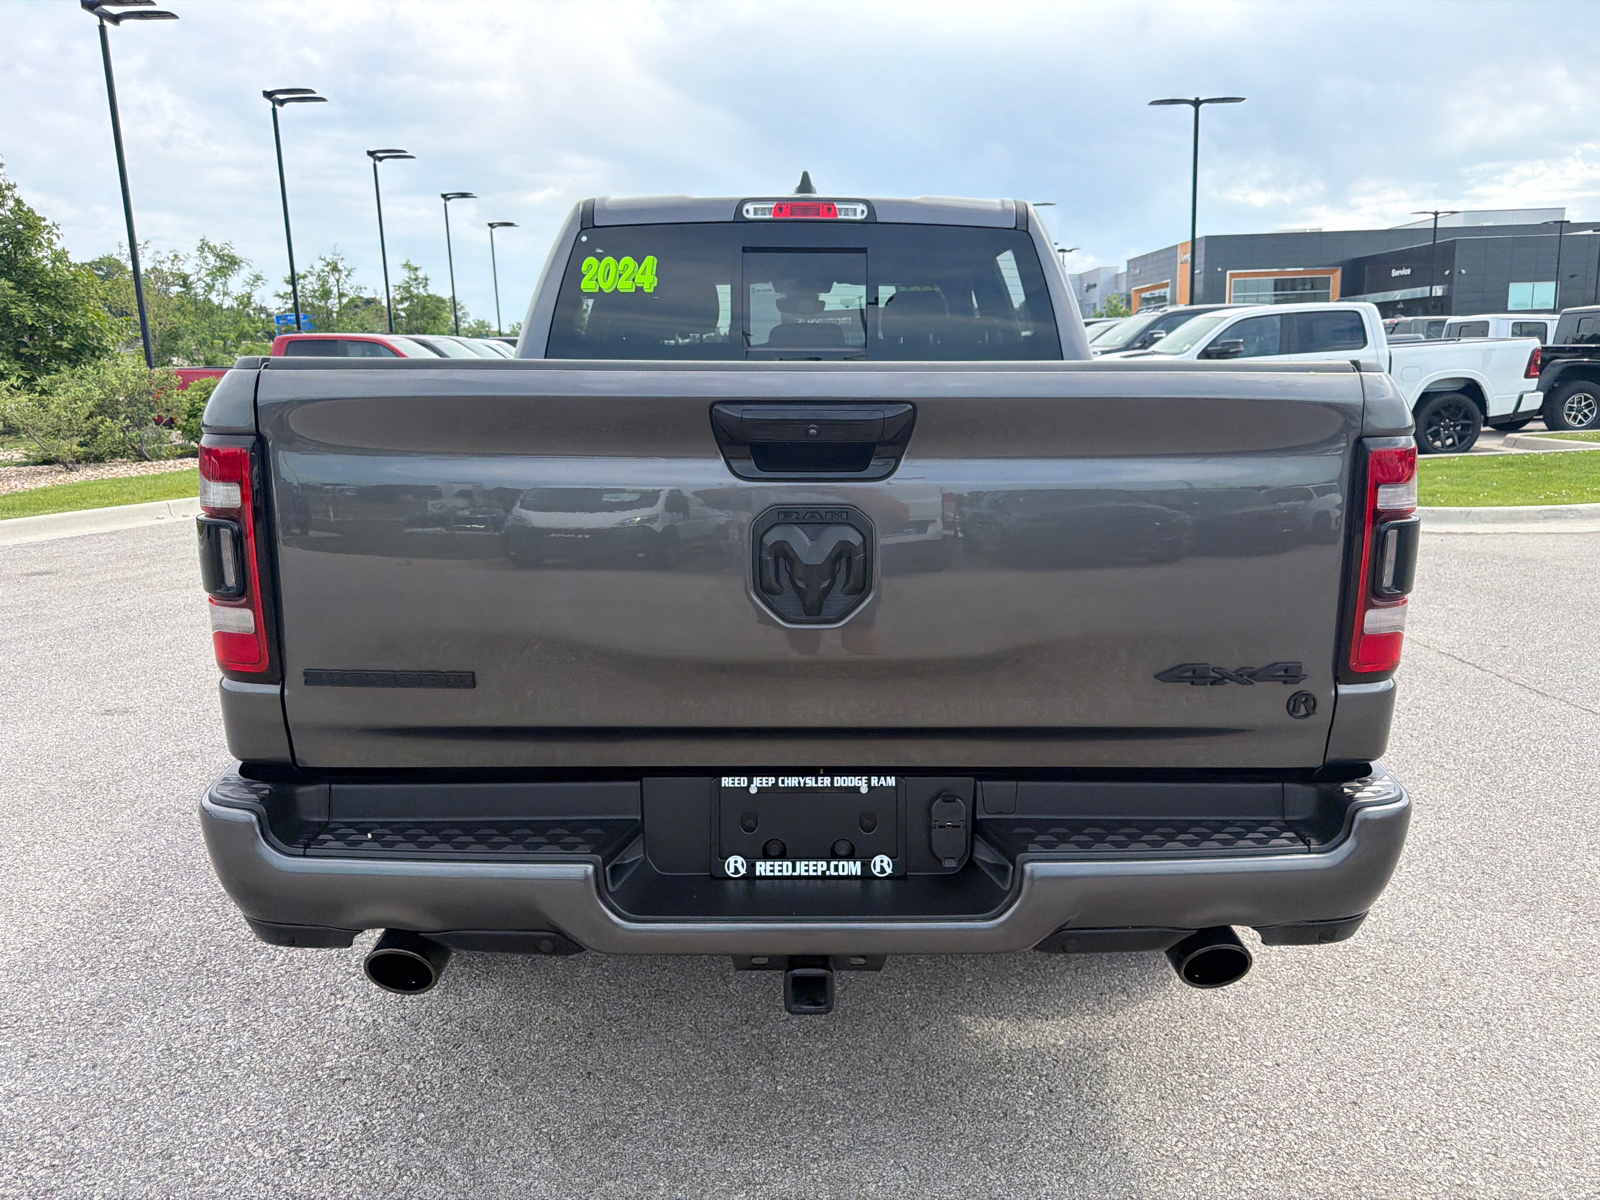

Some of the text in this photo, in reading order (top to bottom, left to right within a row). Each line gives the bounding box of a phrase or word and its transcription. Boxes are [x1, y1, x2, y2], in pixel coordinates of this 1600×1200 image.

[581, 256, 658, 293] 2024
[1391, 267, 1412, 278] Service
[777, 510, 849, 521] RAM
[721, 776, 896, 788] REED JEEP CHRYSLER DODGE RAM
[755, 860, 862, 877] REEDJEEP.COM
